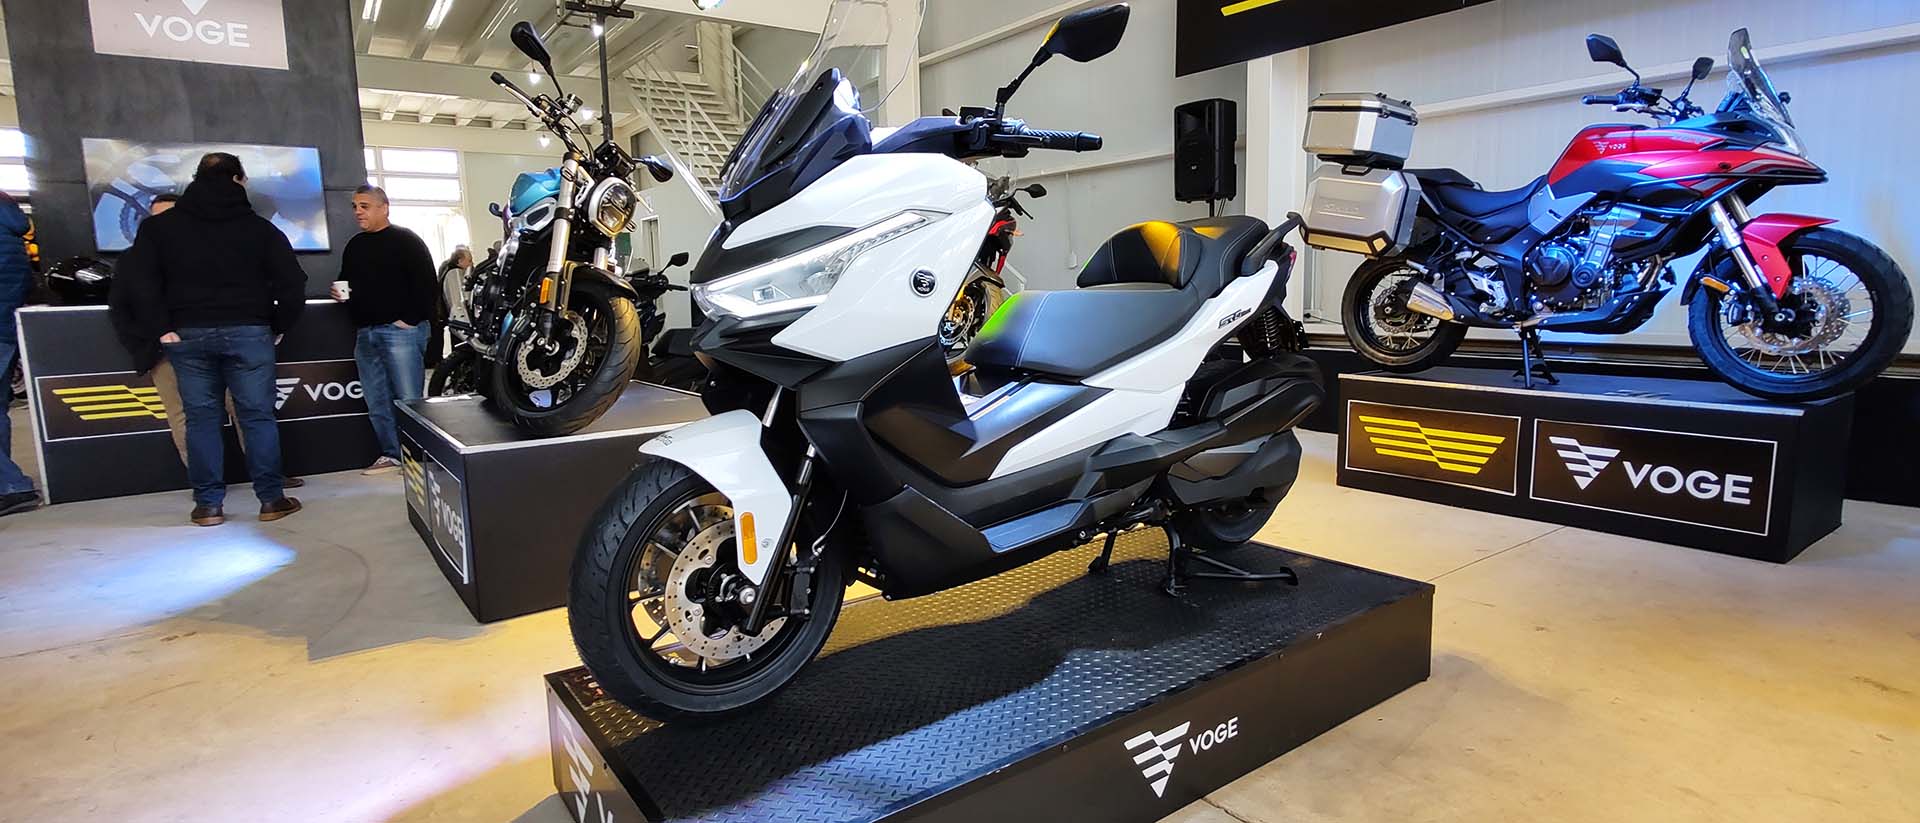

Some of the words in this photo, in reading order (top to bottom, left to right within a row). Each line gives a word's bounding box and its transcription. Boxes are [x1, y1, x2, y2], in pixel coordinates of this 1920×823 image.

[134, 12, 250, 48] VOGE
[303, 380, 364, 402] VOG
[1622, 460, 1753, 506] VOGE
[1189, 716, 1239, 756] VOGE
